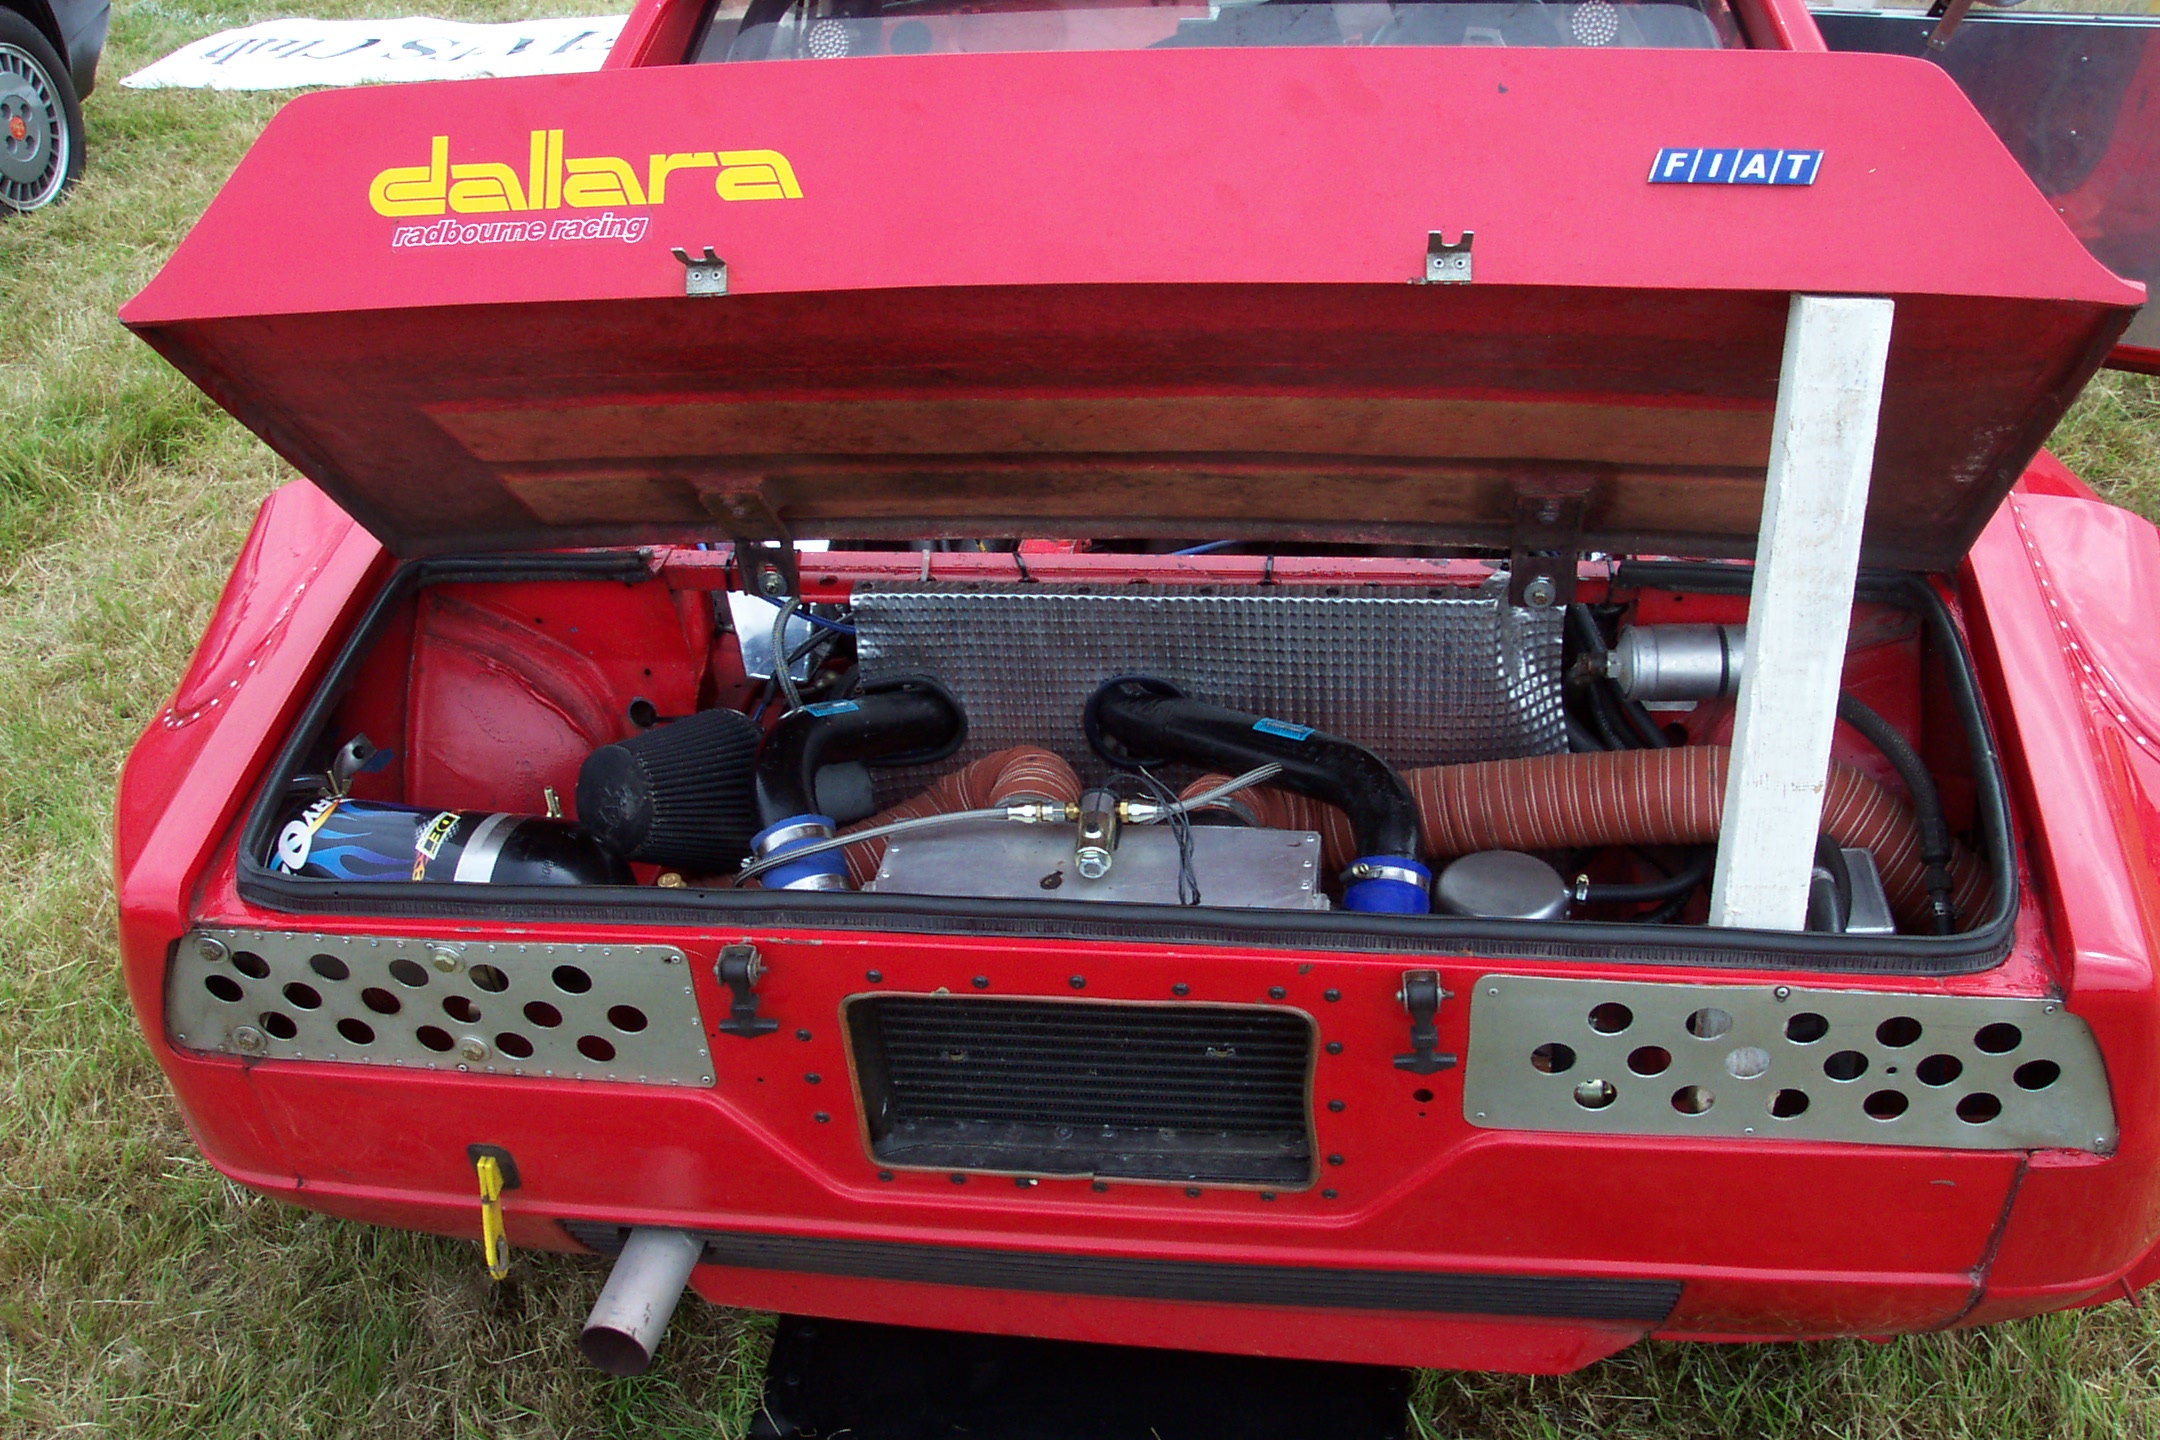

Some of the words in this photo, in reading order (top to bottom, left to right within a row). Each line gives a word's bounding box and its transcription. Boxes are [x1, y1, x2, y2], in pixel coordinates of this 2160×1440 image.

[368, 129, 804, 217] dallara
[1663, 152, 1811, 179] FIAT
[392, 218, 545, 248] radbourne
[548, 212, 648, 243] racing
